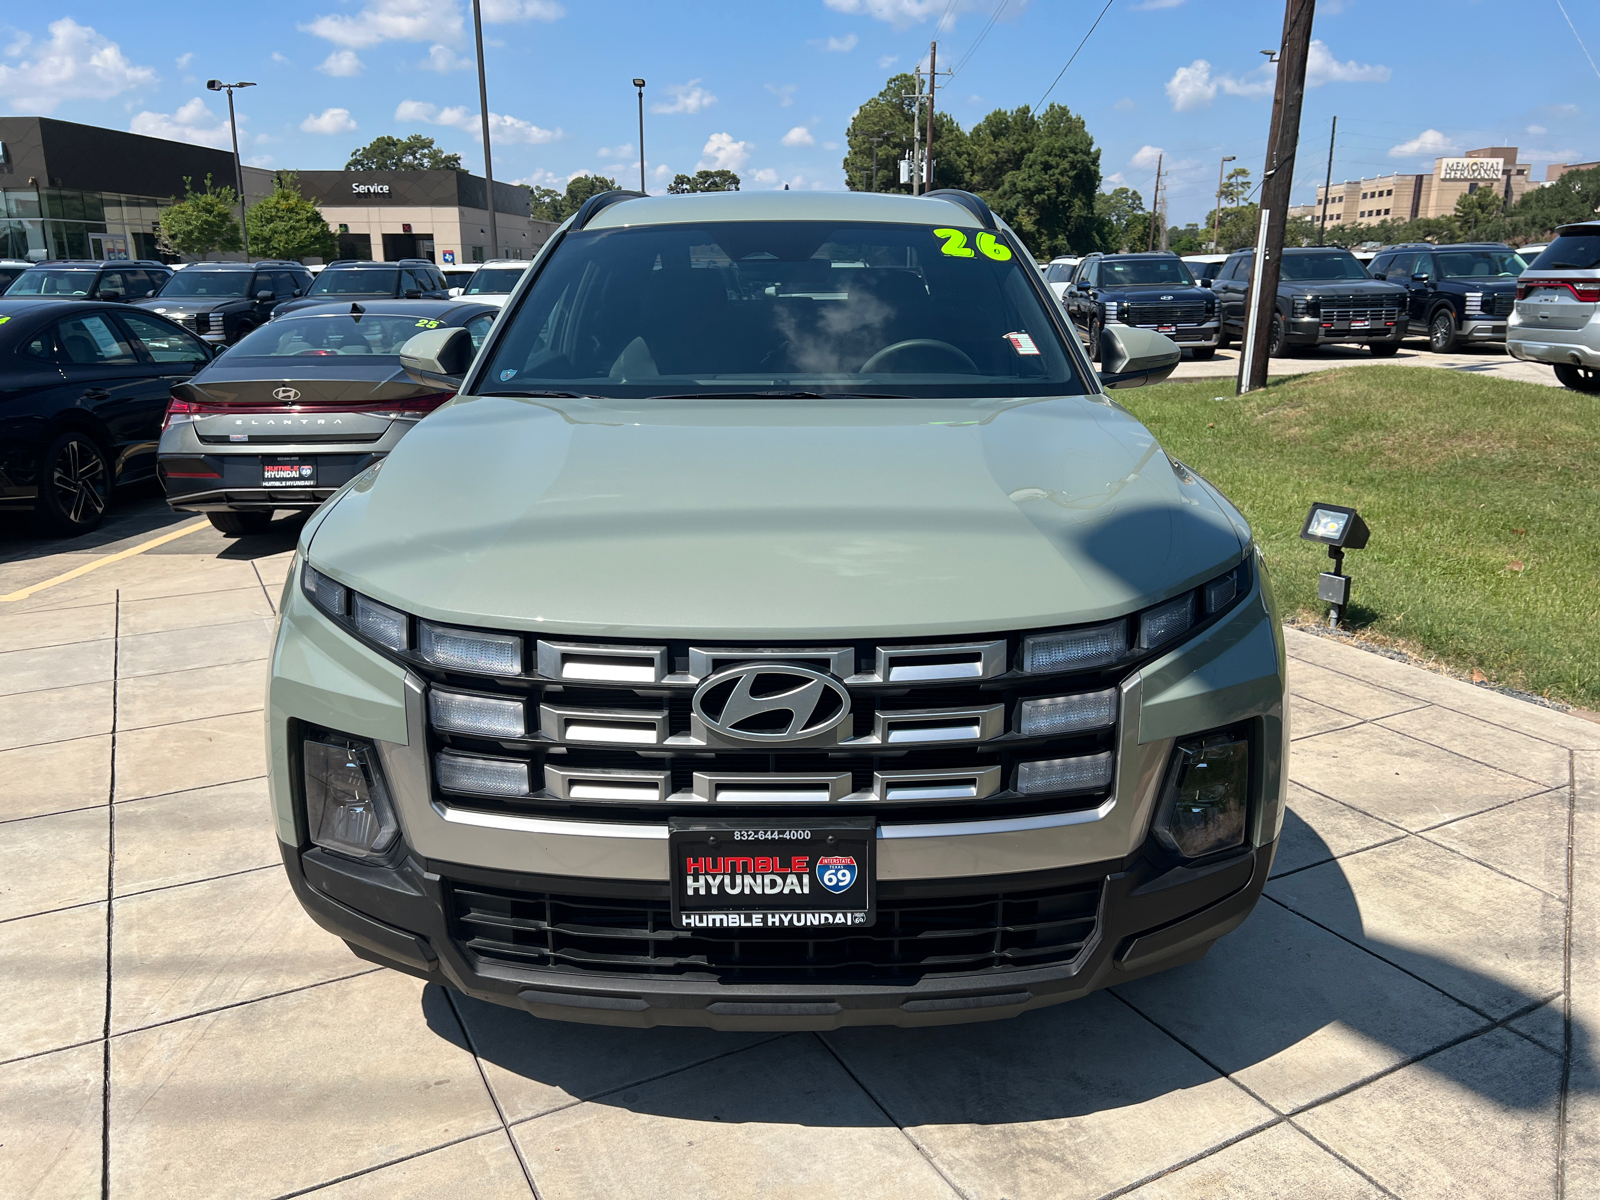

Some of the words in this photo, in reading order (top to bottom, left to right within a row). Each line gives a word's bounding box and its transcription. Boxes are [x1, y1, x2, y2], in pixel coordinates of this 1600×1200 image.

[1445, 162, 1500, 171] MEMORIAL
[1444, 170, 1499, 178] HERMANN
[352, 183, 389, 193] Service
[933, 228, 1012, 261] 26
[415, 319, 440, 329] 25
[264, 470, 299, 478] HYUNDAI
[734, 830, 811, 840] 832-644-4000
[686, 856, 809, 874] HUMBLE
[823, 869, 851, 886] 69
[686, 874, 809, 895] HYUNDAI
[682, 914, 763, 927] HUMBLE
[767, 912, 852, 926] HYUNDAI
